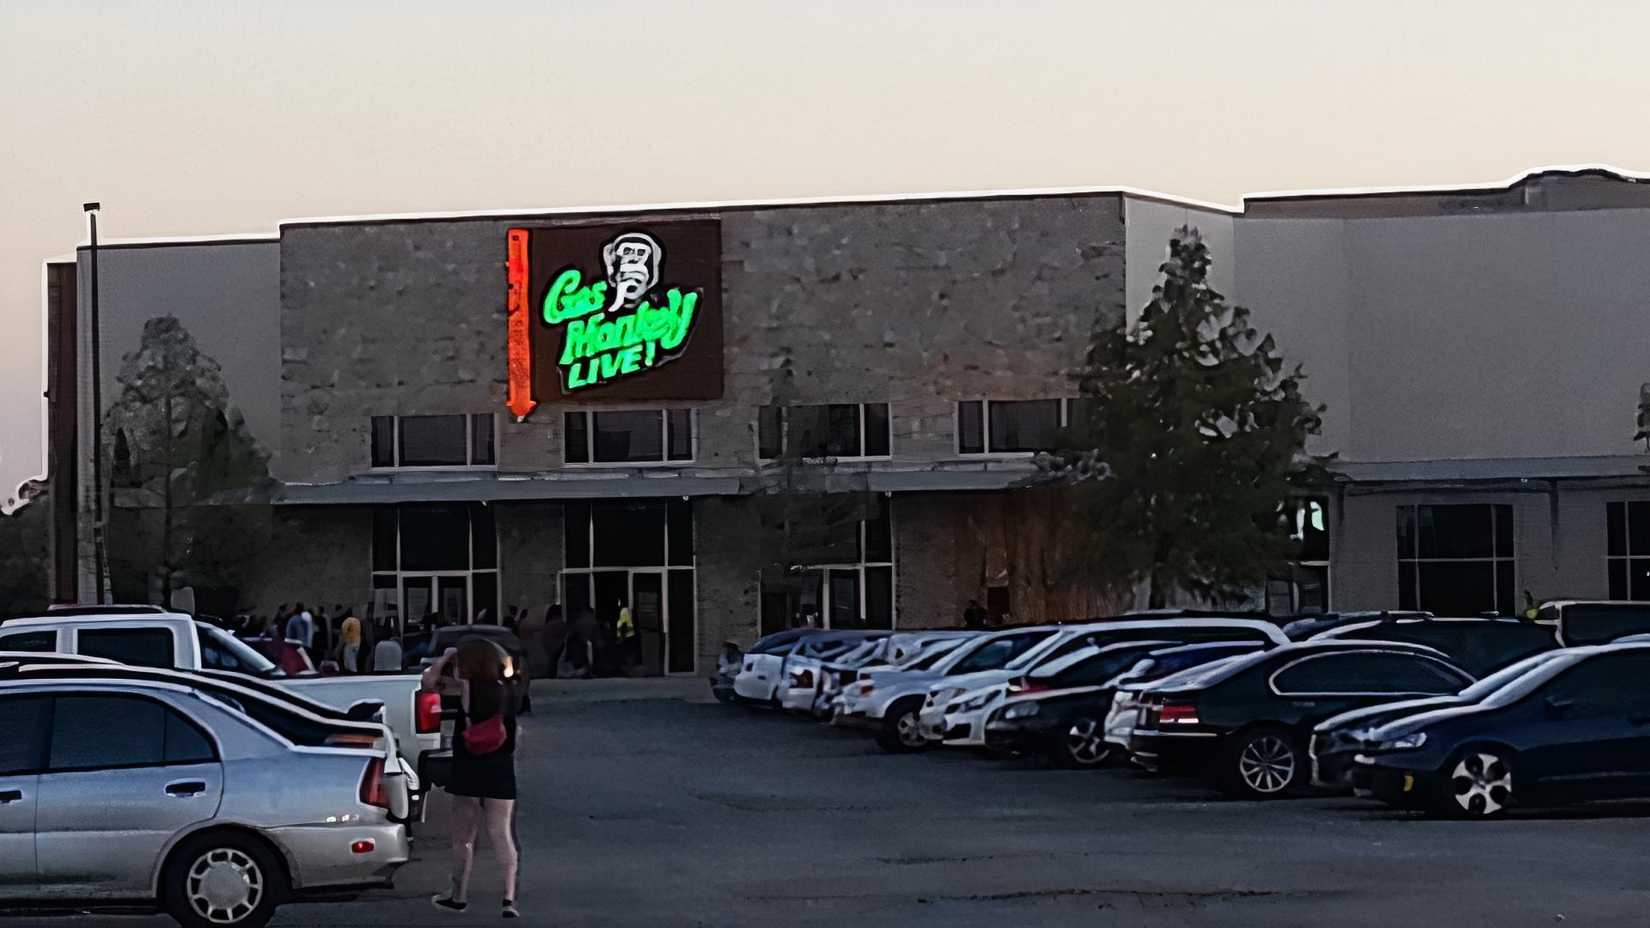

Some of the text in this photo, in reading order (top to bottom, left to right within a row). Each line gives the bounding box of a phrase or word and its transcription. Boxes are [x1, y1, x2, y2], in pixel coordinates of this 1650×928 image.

[543, 269, 608, 324] Gas
[559, 288, 698, 366] Monkey
[568, 341, 656, 389] LIVE!
